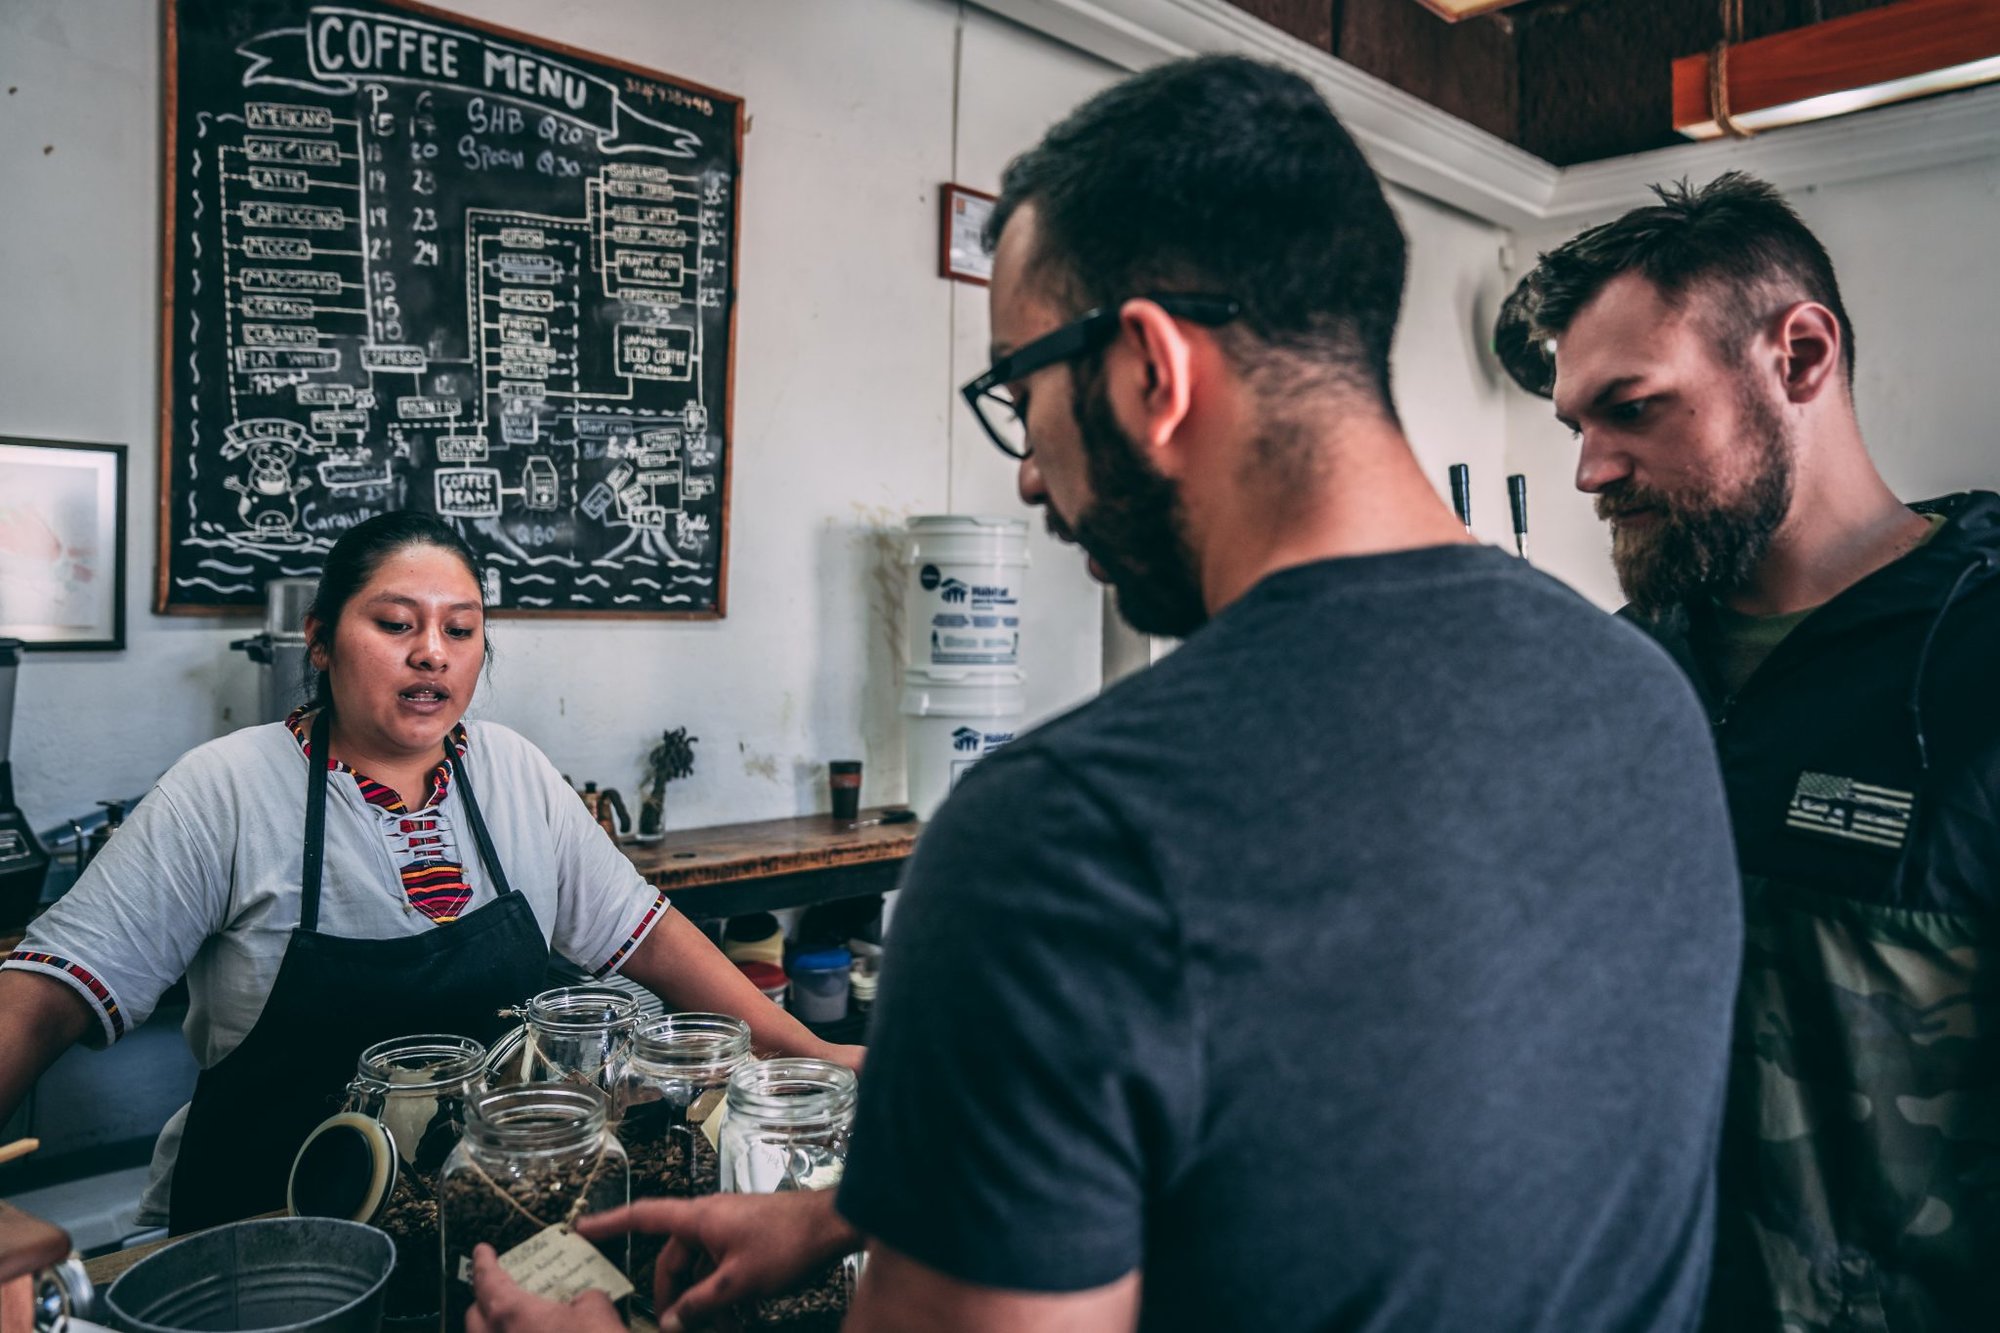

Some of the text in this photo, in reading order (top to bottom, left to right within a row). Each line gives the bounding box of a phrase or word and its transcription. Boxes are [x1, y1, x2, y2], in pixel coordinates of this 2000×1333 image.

[318, 17, 459, 78] COFFEE
[484, 50, 587, 110] MENU
[250, 105, 328, 127] AMERICANO
[467, 96, 525, 134] SHB
[254, 169, 300, 188] LATTE
[241, 351, 277, 367] FLAT
[232, 424, 296, 445] LECHE
[441, 474, 492, 491] COFFEE
[444, 489, 490, 505] BEAN
